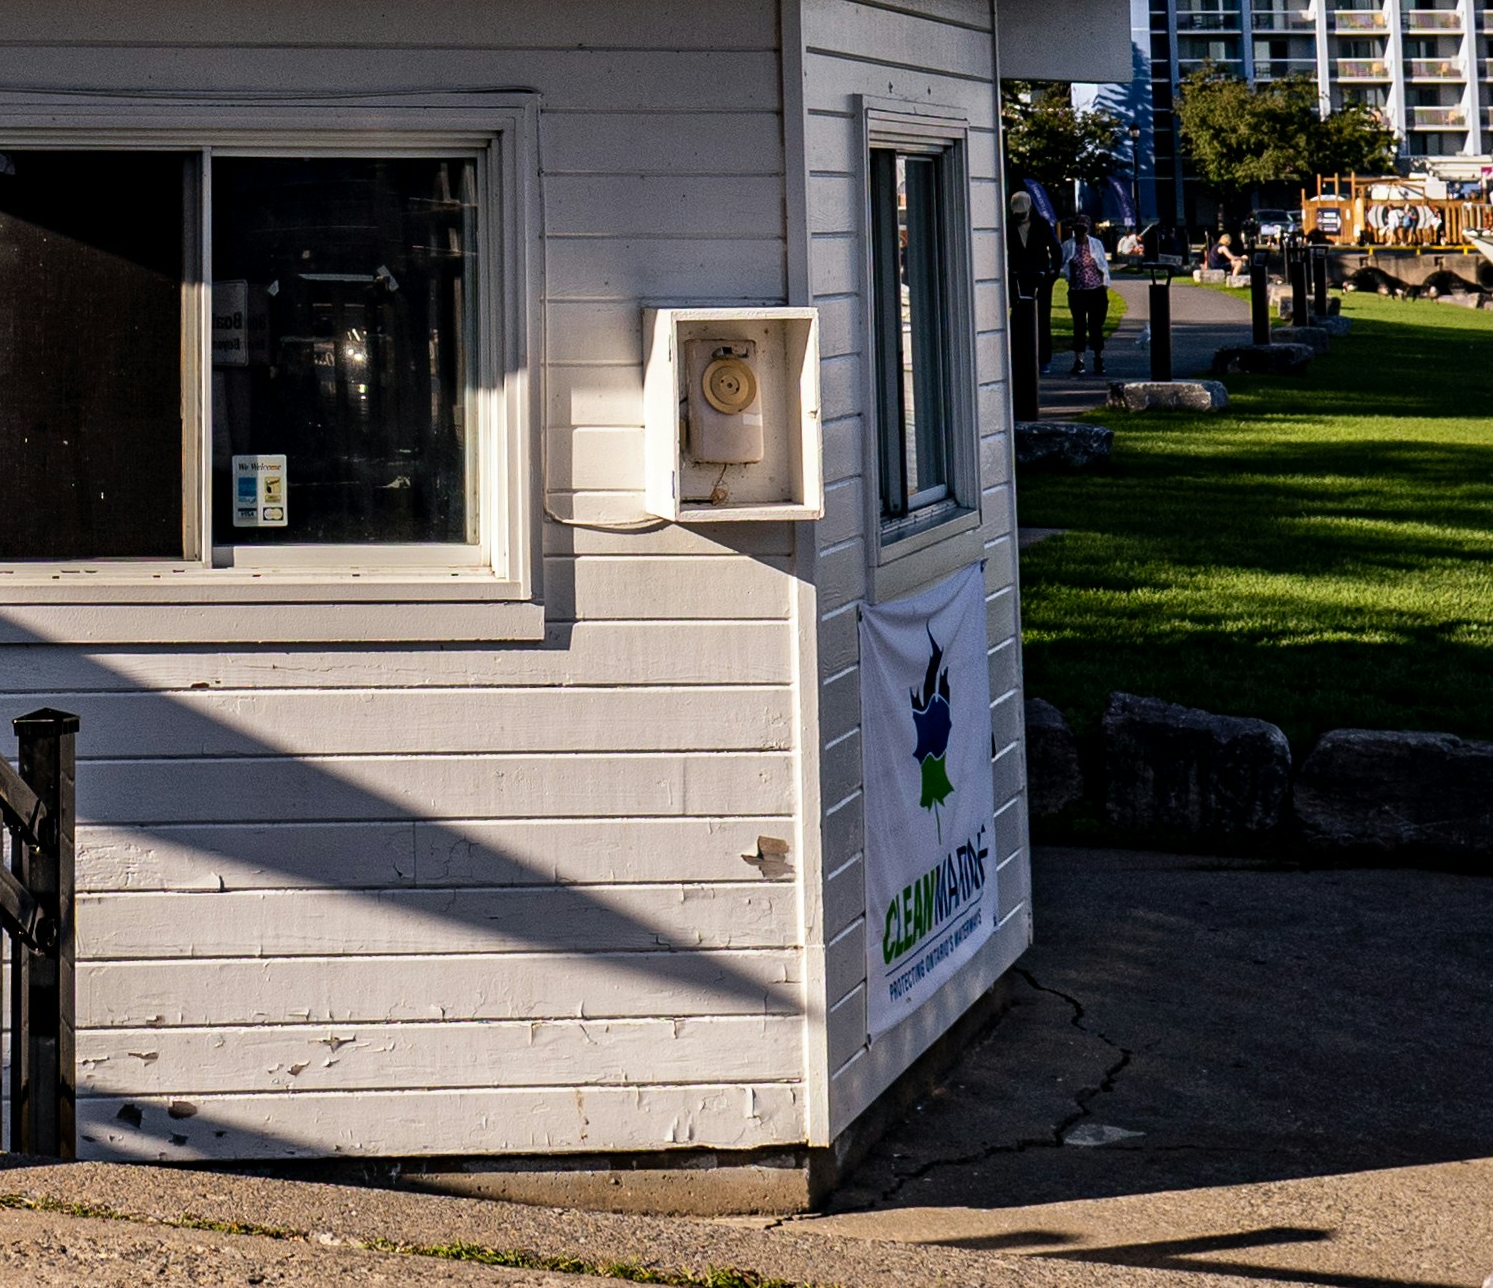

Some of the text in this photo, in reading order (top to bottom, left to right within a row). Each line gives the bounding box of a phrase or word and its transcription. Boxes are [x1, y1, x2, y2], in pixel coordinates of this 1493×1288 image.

[238, 462, 282, 471] We Welcome
[889, 959, 925, 1003] PROTECTING
[925, 935, 954, 974] ONTARIO'S
